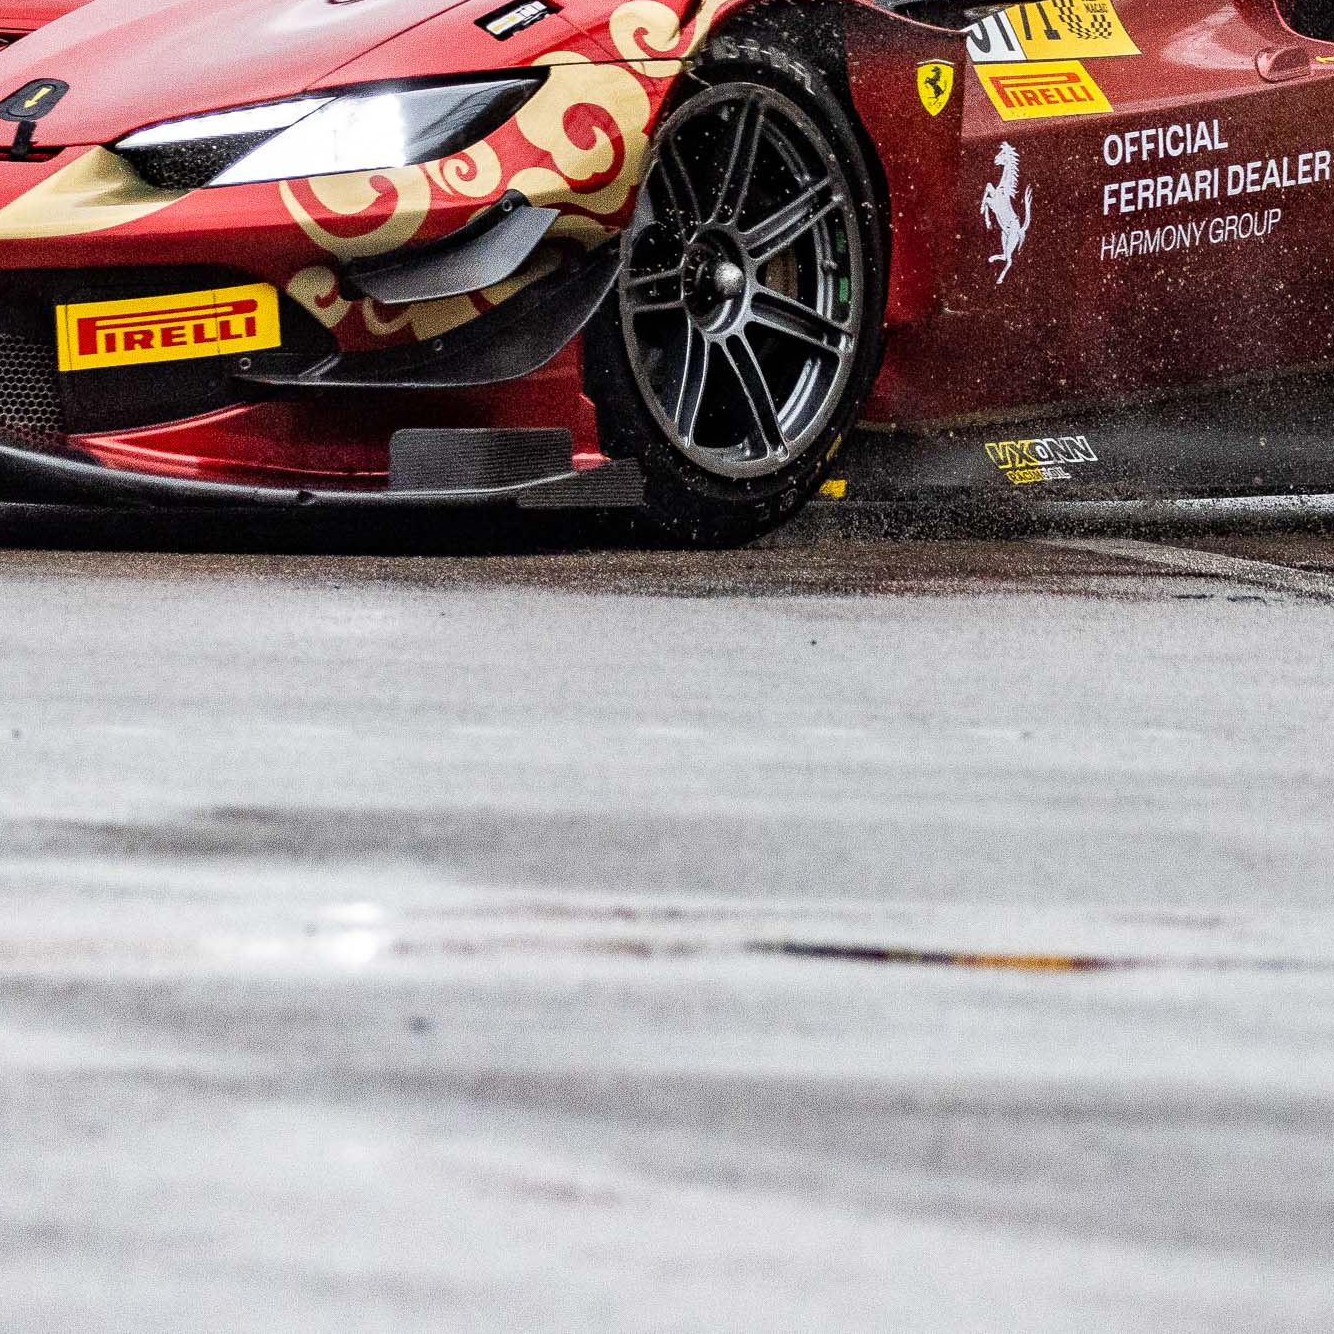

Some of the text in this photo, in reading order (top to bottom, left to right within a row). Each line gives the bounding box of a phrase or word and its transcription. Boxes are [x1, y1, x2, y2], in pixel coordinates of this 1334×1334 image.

[989, 72, 1095, 108] PIRELLI
[1103, 119, 1229, 166] OFFICIAL
[1103, 150, 1332, 216] FERRARI DEALER
[1100, 208, 1282, 261] HARMONY GROUP
[77, 299, 258, 356] PIRELLI
[985, 436, 1098, 469] VXONN
